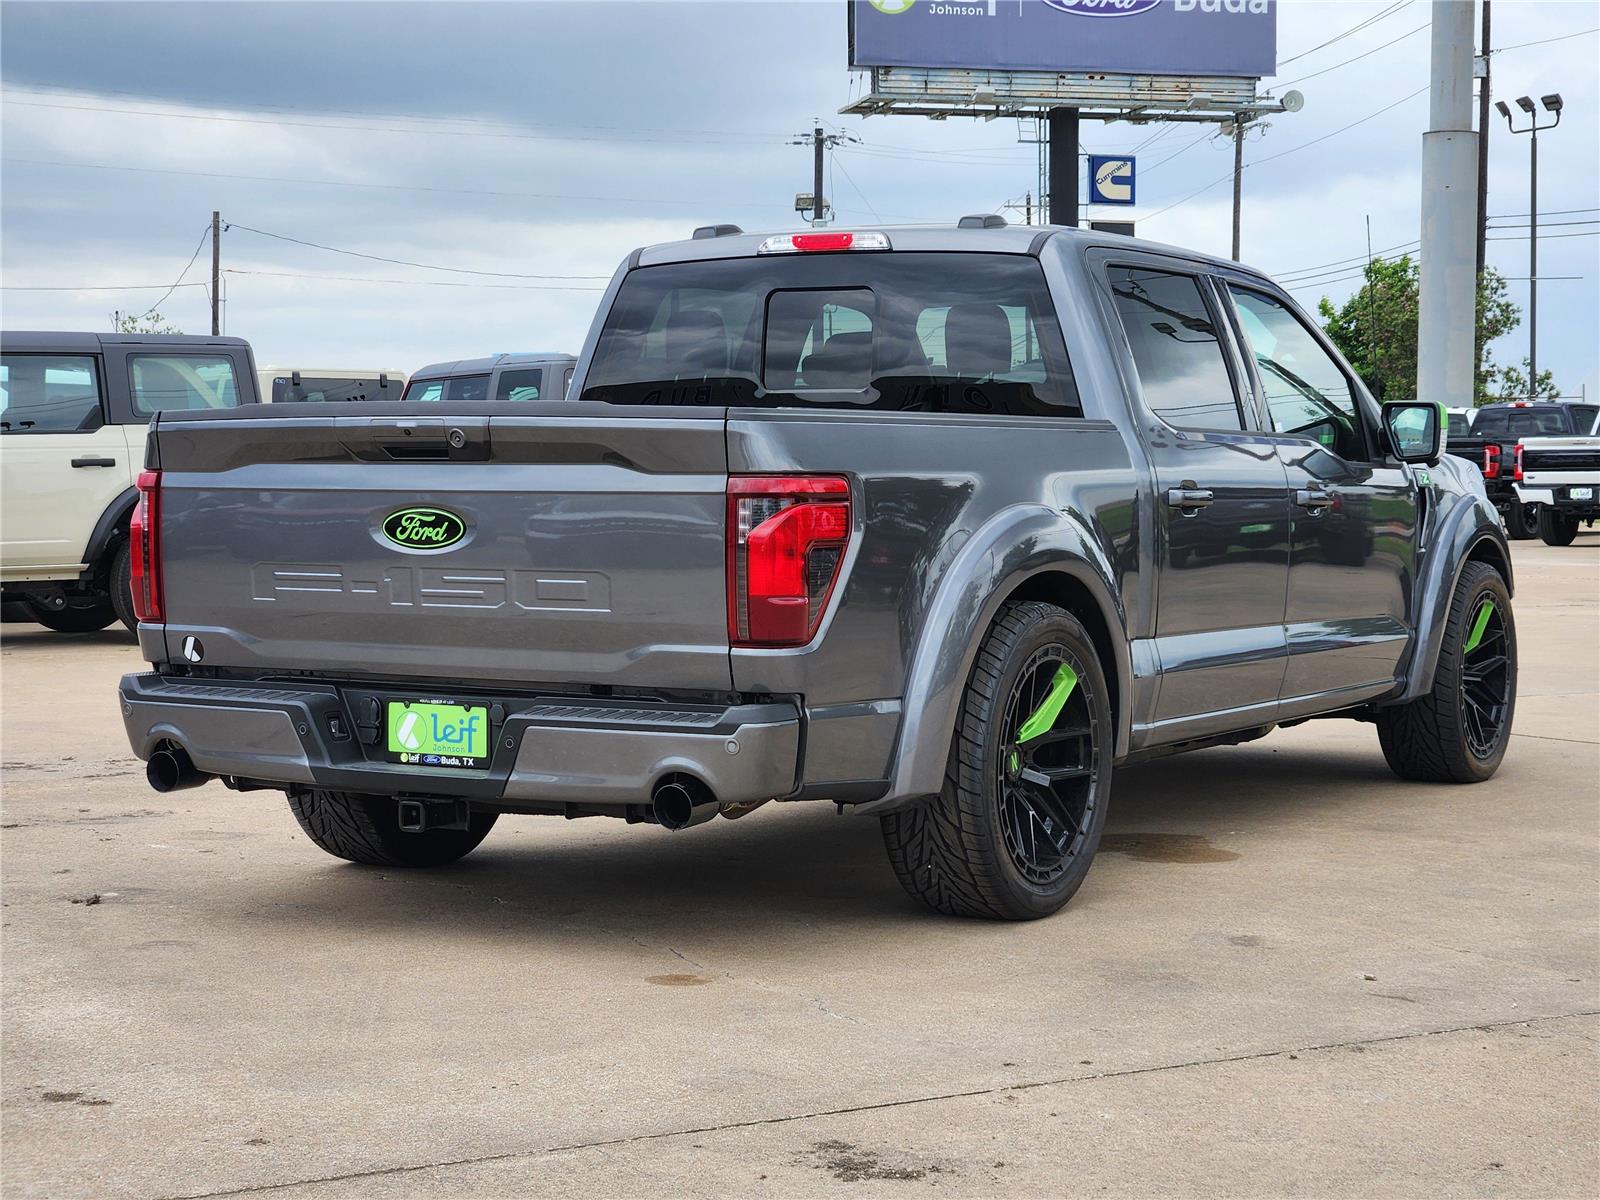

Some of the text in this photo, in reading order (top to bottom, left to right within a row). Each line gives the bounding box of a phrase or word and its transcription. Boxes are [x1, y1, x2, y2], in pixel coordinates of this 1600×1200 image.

[928, 4, 984, 16] Johnson
[1173, 0, 1268, 14] Buda
[1096, 161, 1128, 185] Cummins
[396, 514, 448, 542] Ford
[252, 561, 612, 612] F-150
[432, 744, 465, 753] Johnson
[441, 756, 461, 766] Buda,
[462, 758, 474, 766] TX
